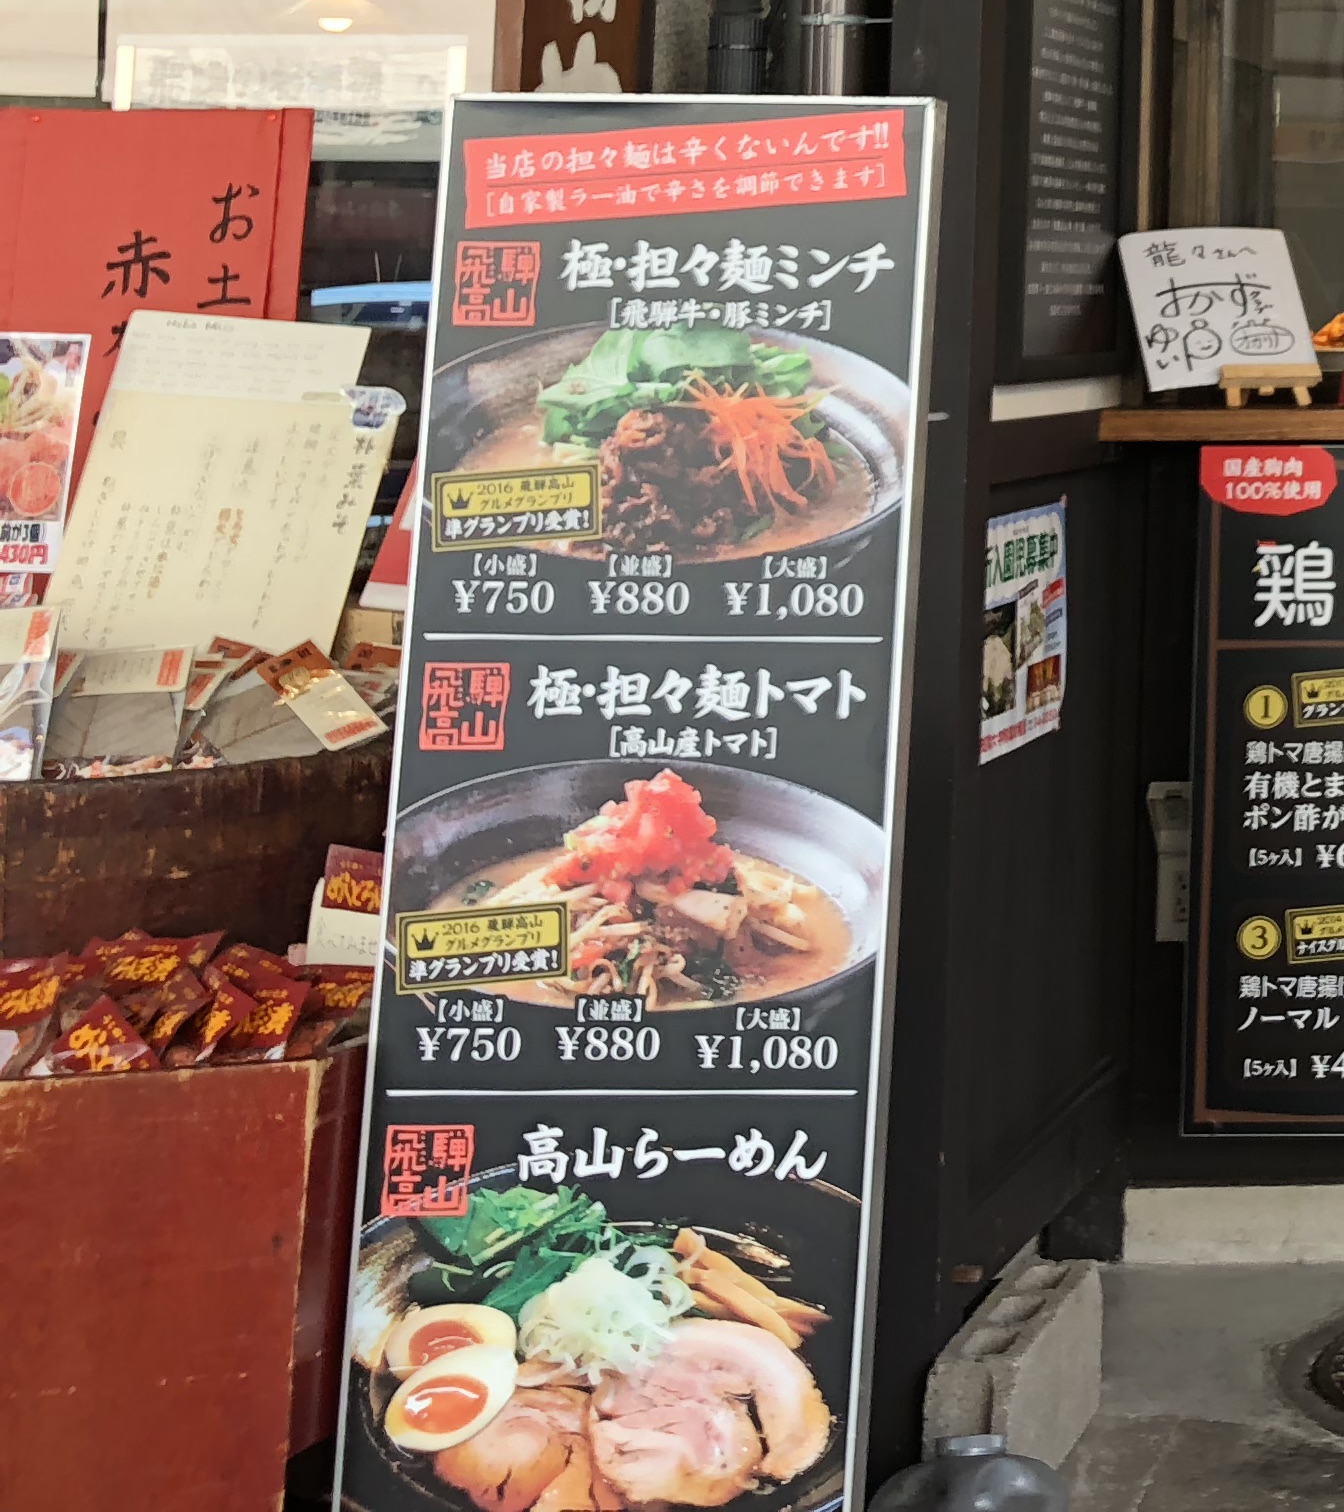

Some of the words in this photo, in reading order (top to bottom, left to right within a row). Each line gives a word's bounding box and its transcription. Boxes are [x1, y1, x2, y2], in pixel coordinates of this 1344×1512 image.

[1223, 480, 1323, 501] 100%使用
[452, 580, 556, 615] ¥750
[588, 581, 690, 617] ¥880
[723, 583, 865, 621] ¥1,080
[1251, 925, 1269, 950] 3
[1236, 1006, 1340, 1031] ノーマル
[417, 1026, 522, 1062] ¥750
[555, 1026, 661, 1062] ¥880
[695, 1034, 839, 1074] ¥1,080
[516, 1123, 828, 1184] 高山らーめん
